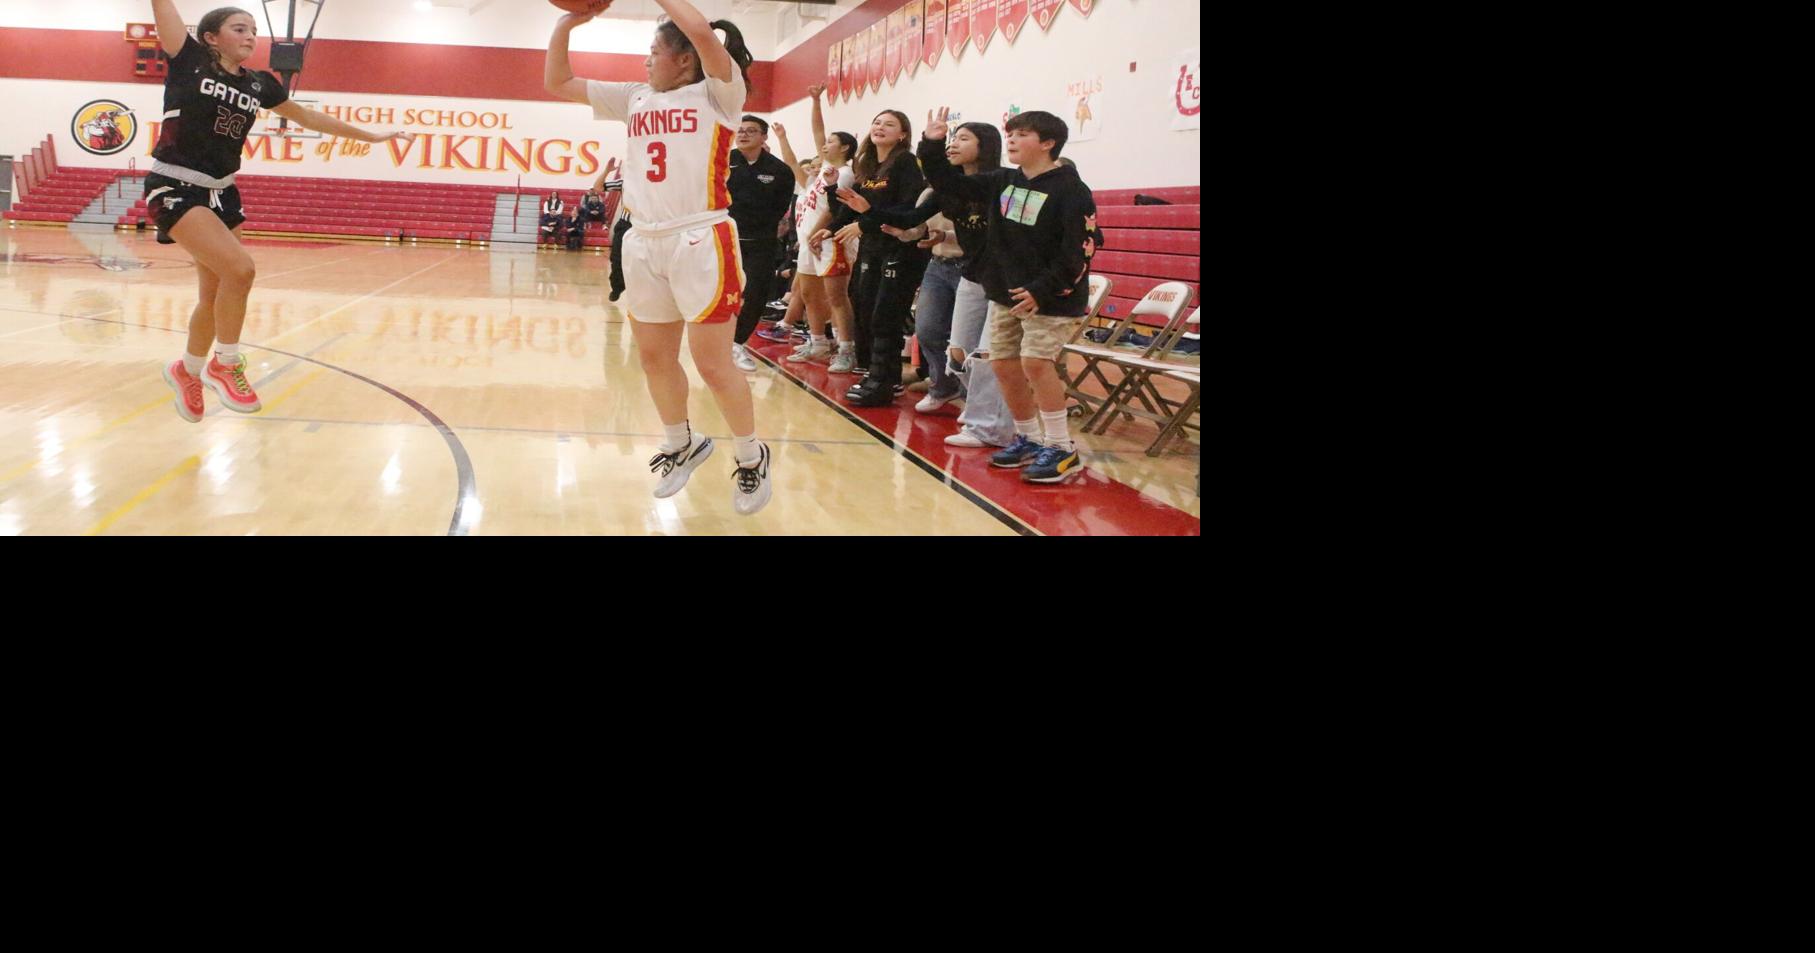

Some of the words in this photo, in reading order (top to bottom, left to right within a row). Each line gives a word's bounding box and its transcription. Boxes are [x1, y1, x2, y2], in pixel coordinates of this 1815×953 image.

[200, 78, 261, 115] GATOR
[322, 104, 394, 124] HIGH
[404, 108, 513, 130] SCHOOL
[627, 109, 698, 138] VIKINGS
[146, 121, 304, 163] ME
[314, 135, 337, 161] of
[338, 137, 371, 157] the
[386, 132, 600, 177] VIKINGS
[646, 141, 667, 183] 3
[884, 269, 896, 279] 31
